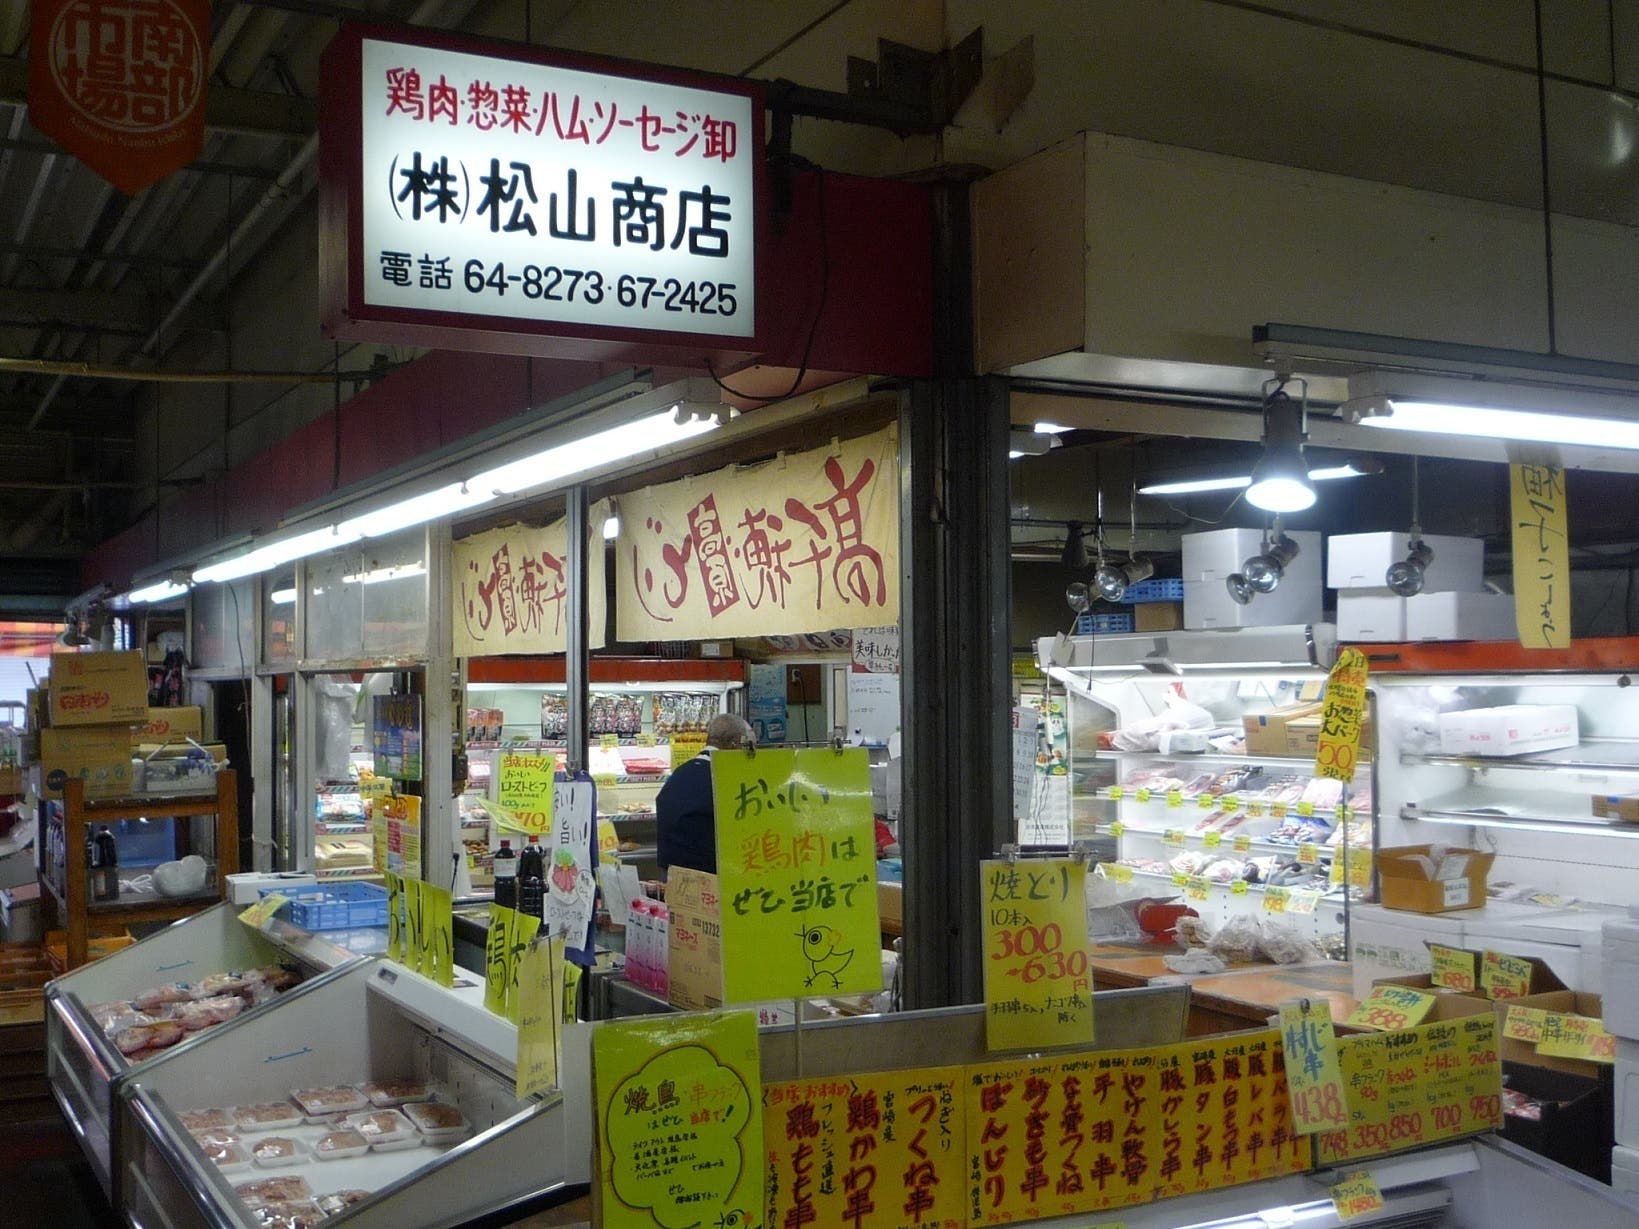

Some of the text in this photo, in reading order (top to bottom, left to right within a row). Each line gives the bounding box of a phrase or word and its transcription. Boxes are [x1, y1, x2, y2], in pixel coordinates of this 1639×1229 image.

[388, 150, 732, 258] (株)松山商店
[380, 250, 453, 290] 電話
[500, 781, 548, 793] ローストビーフ
[734, 778, 830, 821] おいしい
[742, 829, 860, 876] 鶏肉は
[733, 874, 870, 916] ぜひ当店で
[990, 866, 1069, 903] 焼とり
[991, 922, 1063, 961] 300
[981, 1083, 1014, 1208] ぼんじり
[1090, 1071, 1118, 1192] 手羽串
[903, 1094, 941, 1223] つくね串
